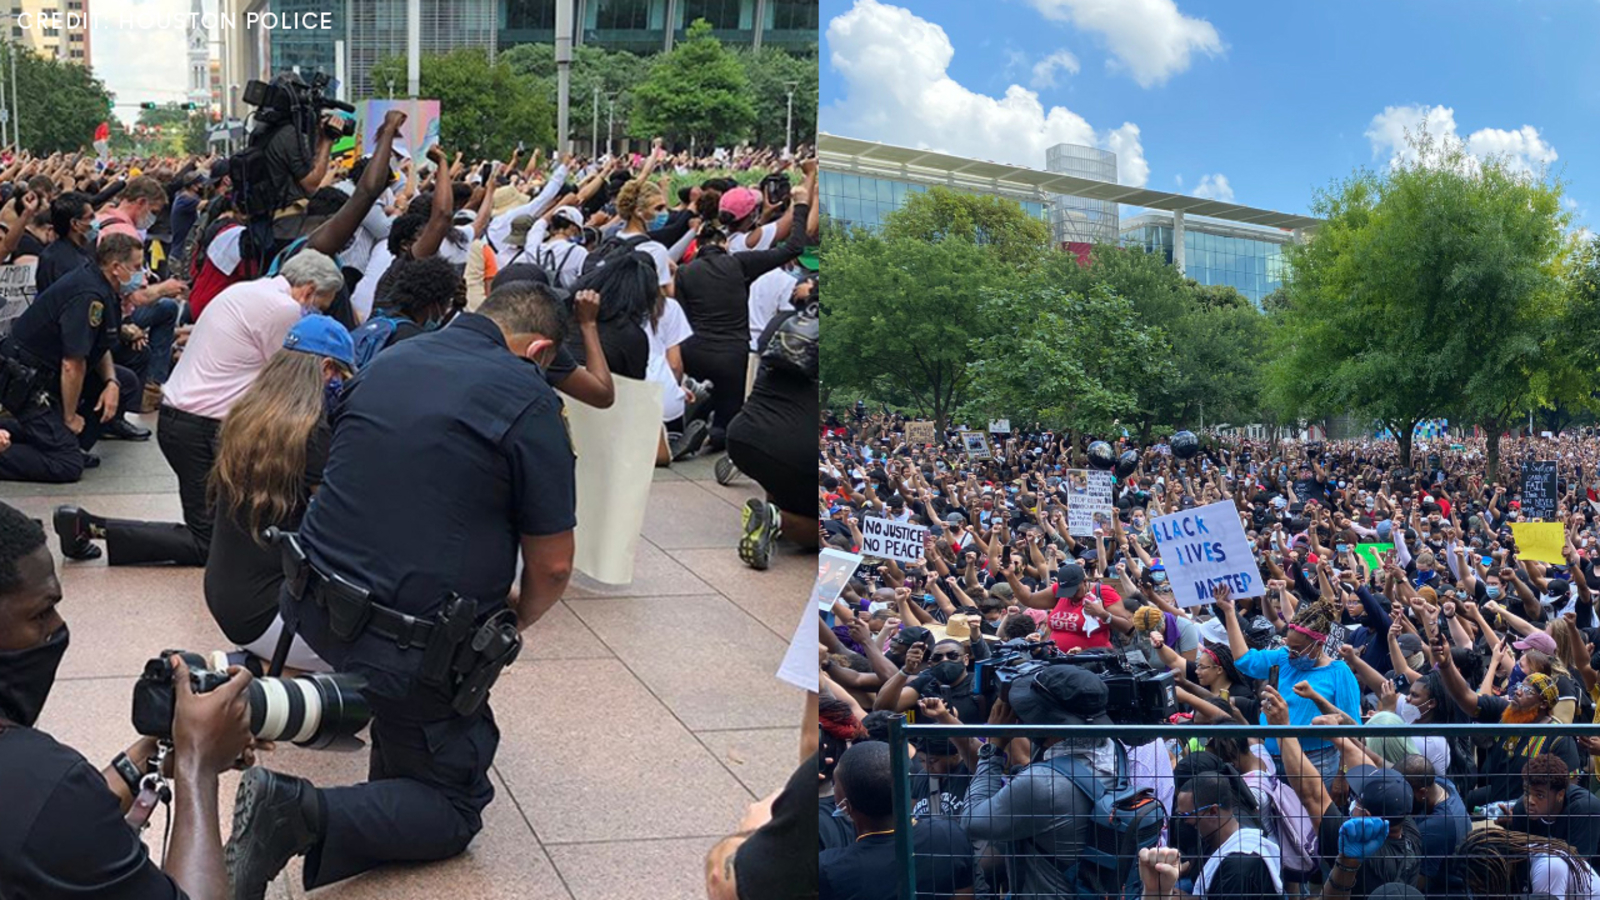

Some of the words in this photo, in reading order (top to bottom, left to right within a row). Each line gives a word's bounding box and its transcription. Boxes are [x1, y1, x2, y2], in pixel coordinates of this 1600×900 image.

[865, 520, 881, 534] NO
[883, 524, 924, 543] JUSTICE
[863, 537, 880, 552] NO
[885, 540, 923, 559] PEACE
[1175, 542, 1227, 566] LIVES
